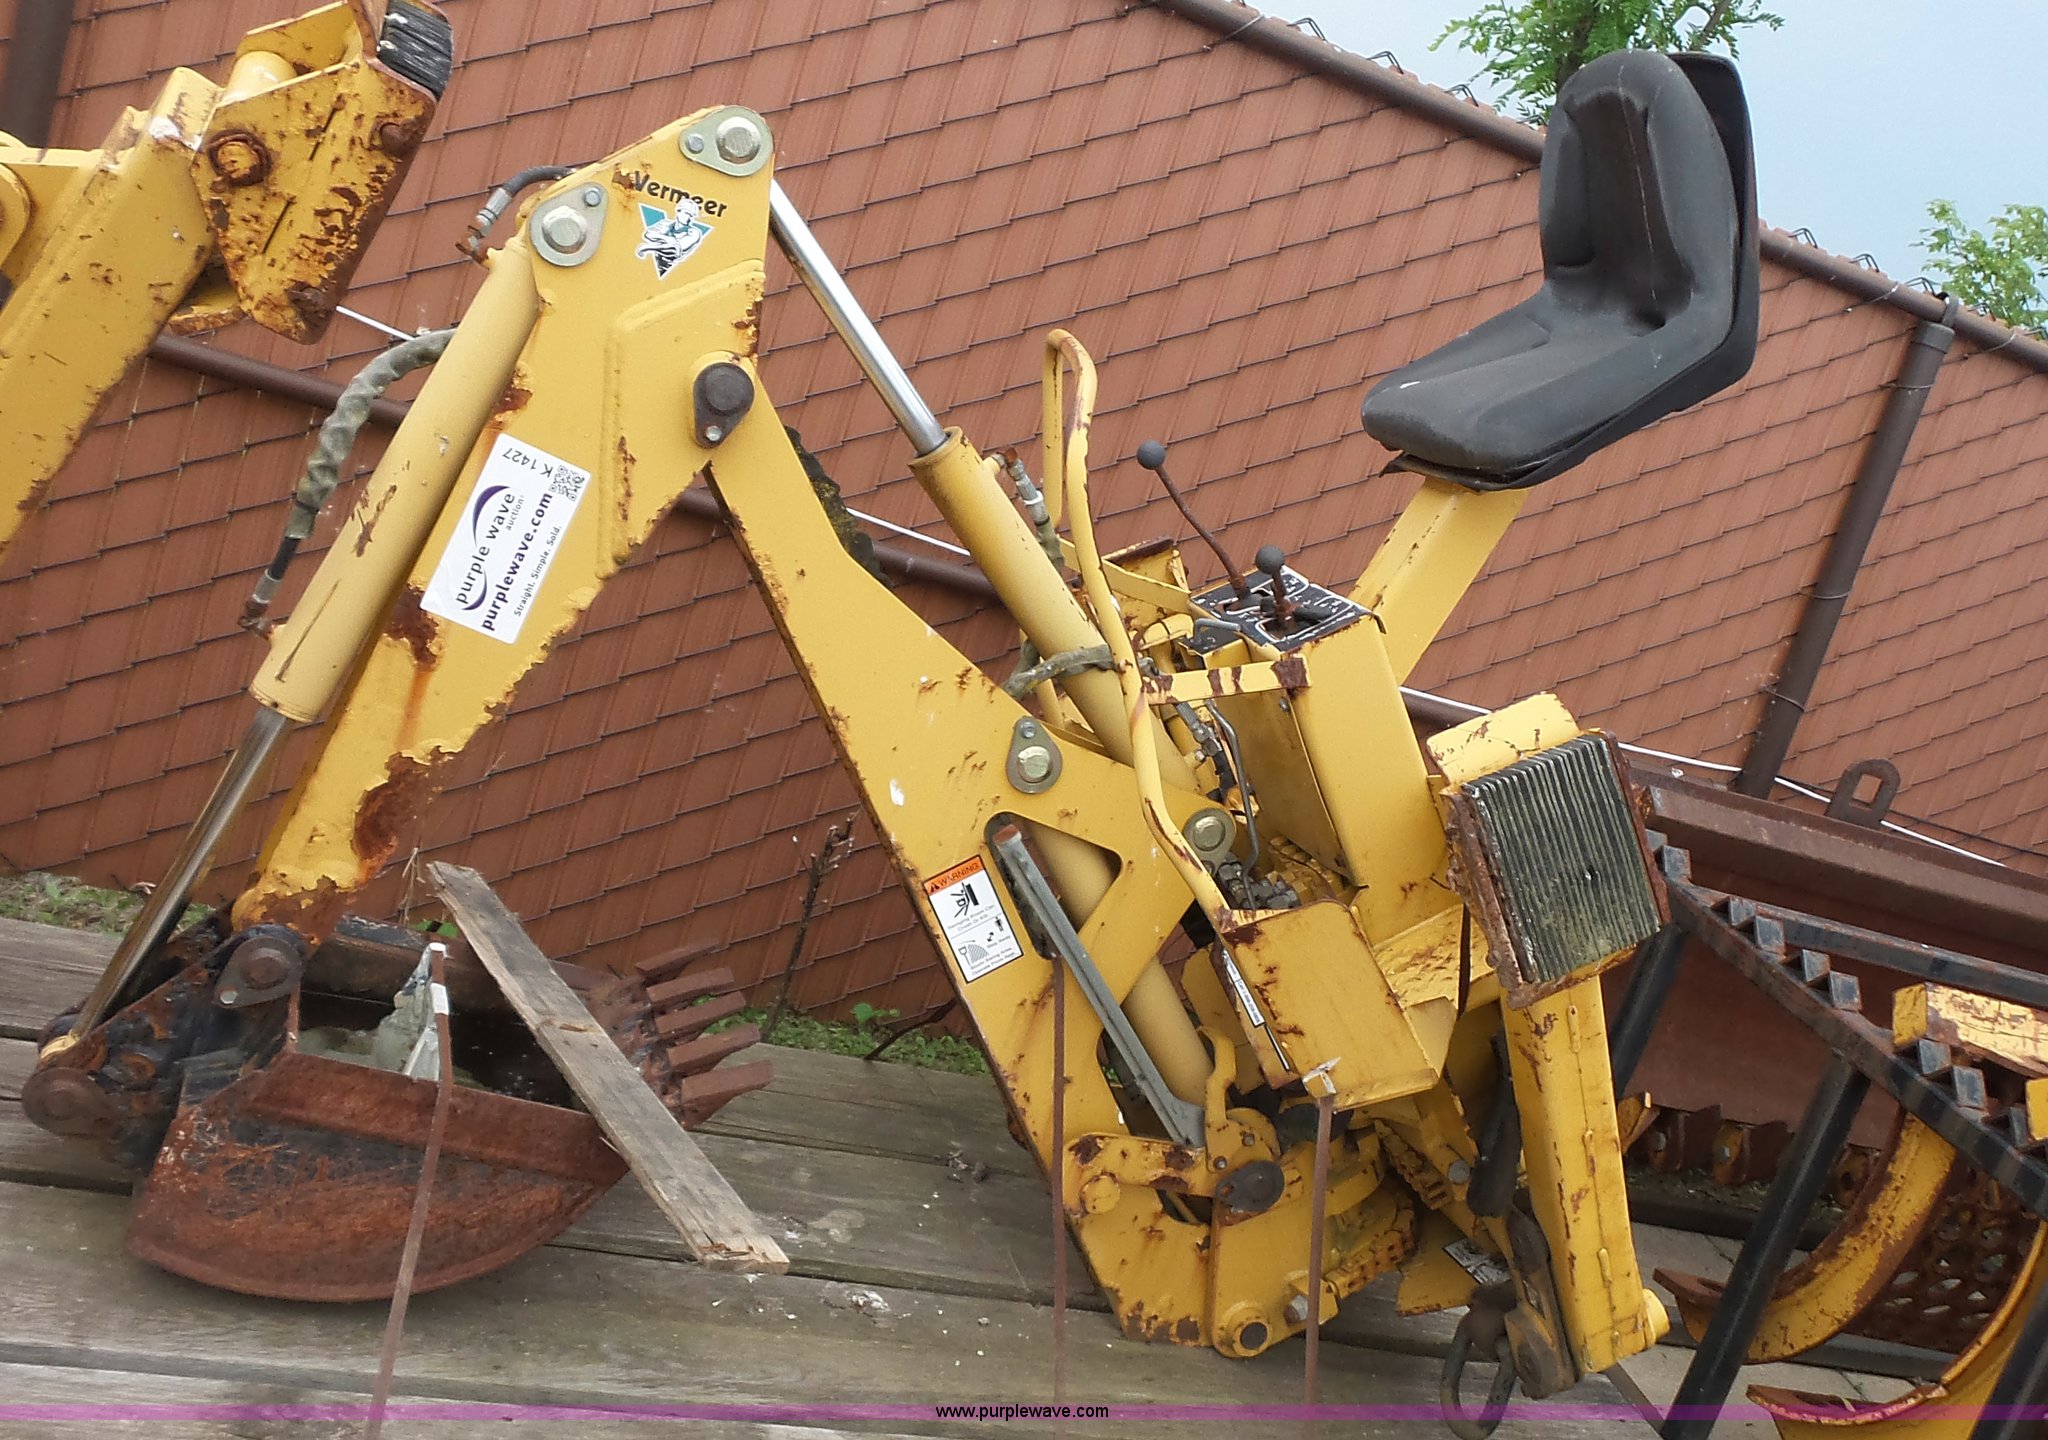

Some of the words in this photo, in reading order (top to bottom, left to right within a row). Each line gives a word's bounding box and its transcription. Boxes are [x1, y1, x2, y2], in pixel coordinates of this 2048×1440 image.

[634, 170, 728, 218] Vermeer
[502, 447, 537, 470] 1427
[540, 463, 554, 478] K
[455, 545, 490, 605] purple
[486, 492, 516, 541] wave
[481, 493, 553, 632] purplewave.com
[513, 581, 536, 617] Straight.
[531, 548, 551, 580] Simple.
[547, 526, 562, 547] Sold.
